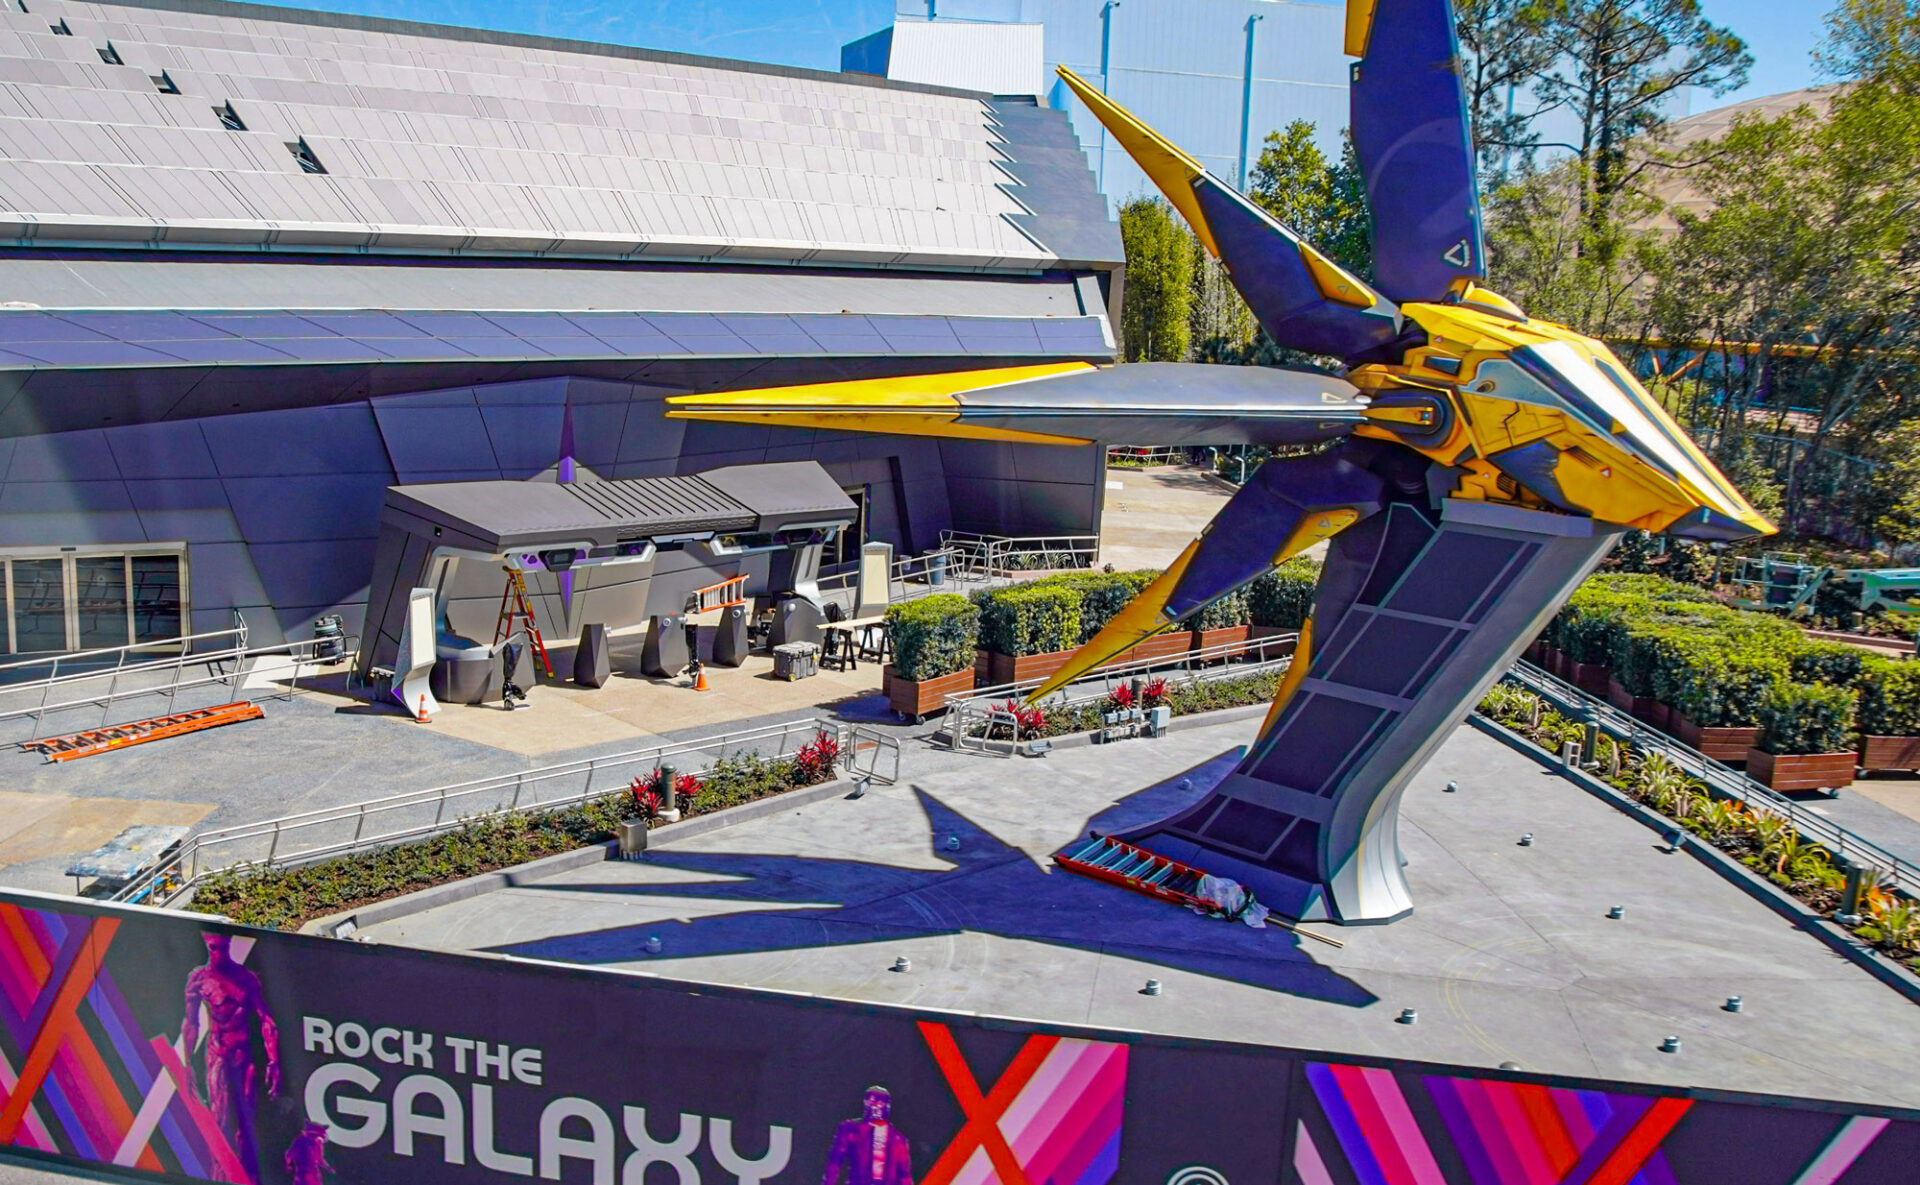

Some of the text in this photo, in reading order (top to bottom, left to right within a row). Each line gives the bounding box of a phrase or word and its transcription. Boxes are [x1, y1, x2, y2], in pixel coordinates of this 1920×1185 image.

[303, 1016, 542, 1086] ROCK THE
[304, 1062, 793, 1185] GALAXY
